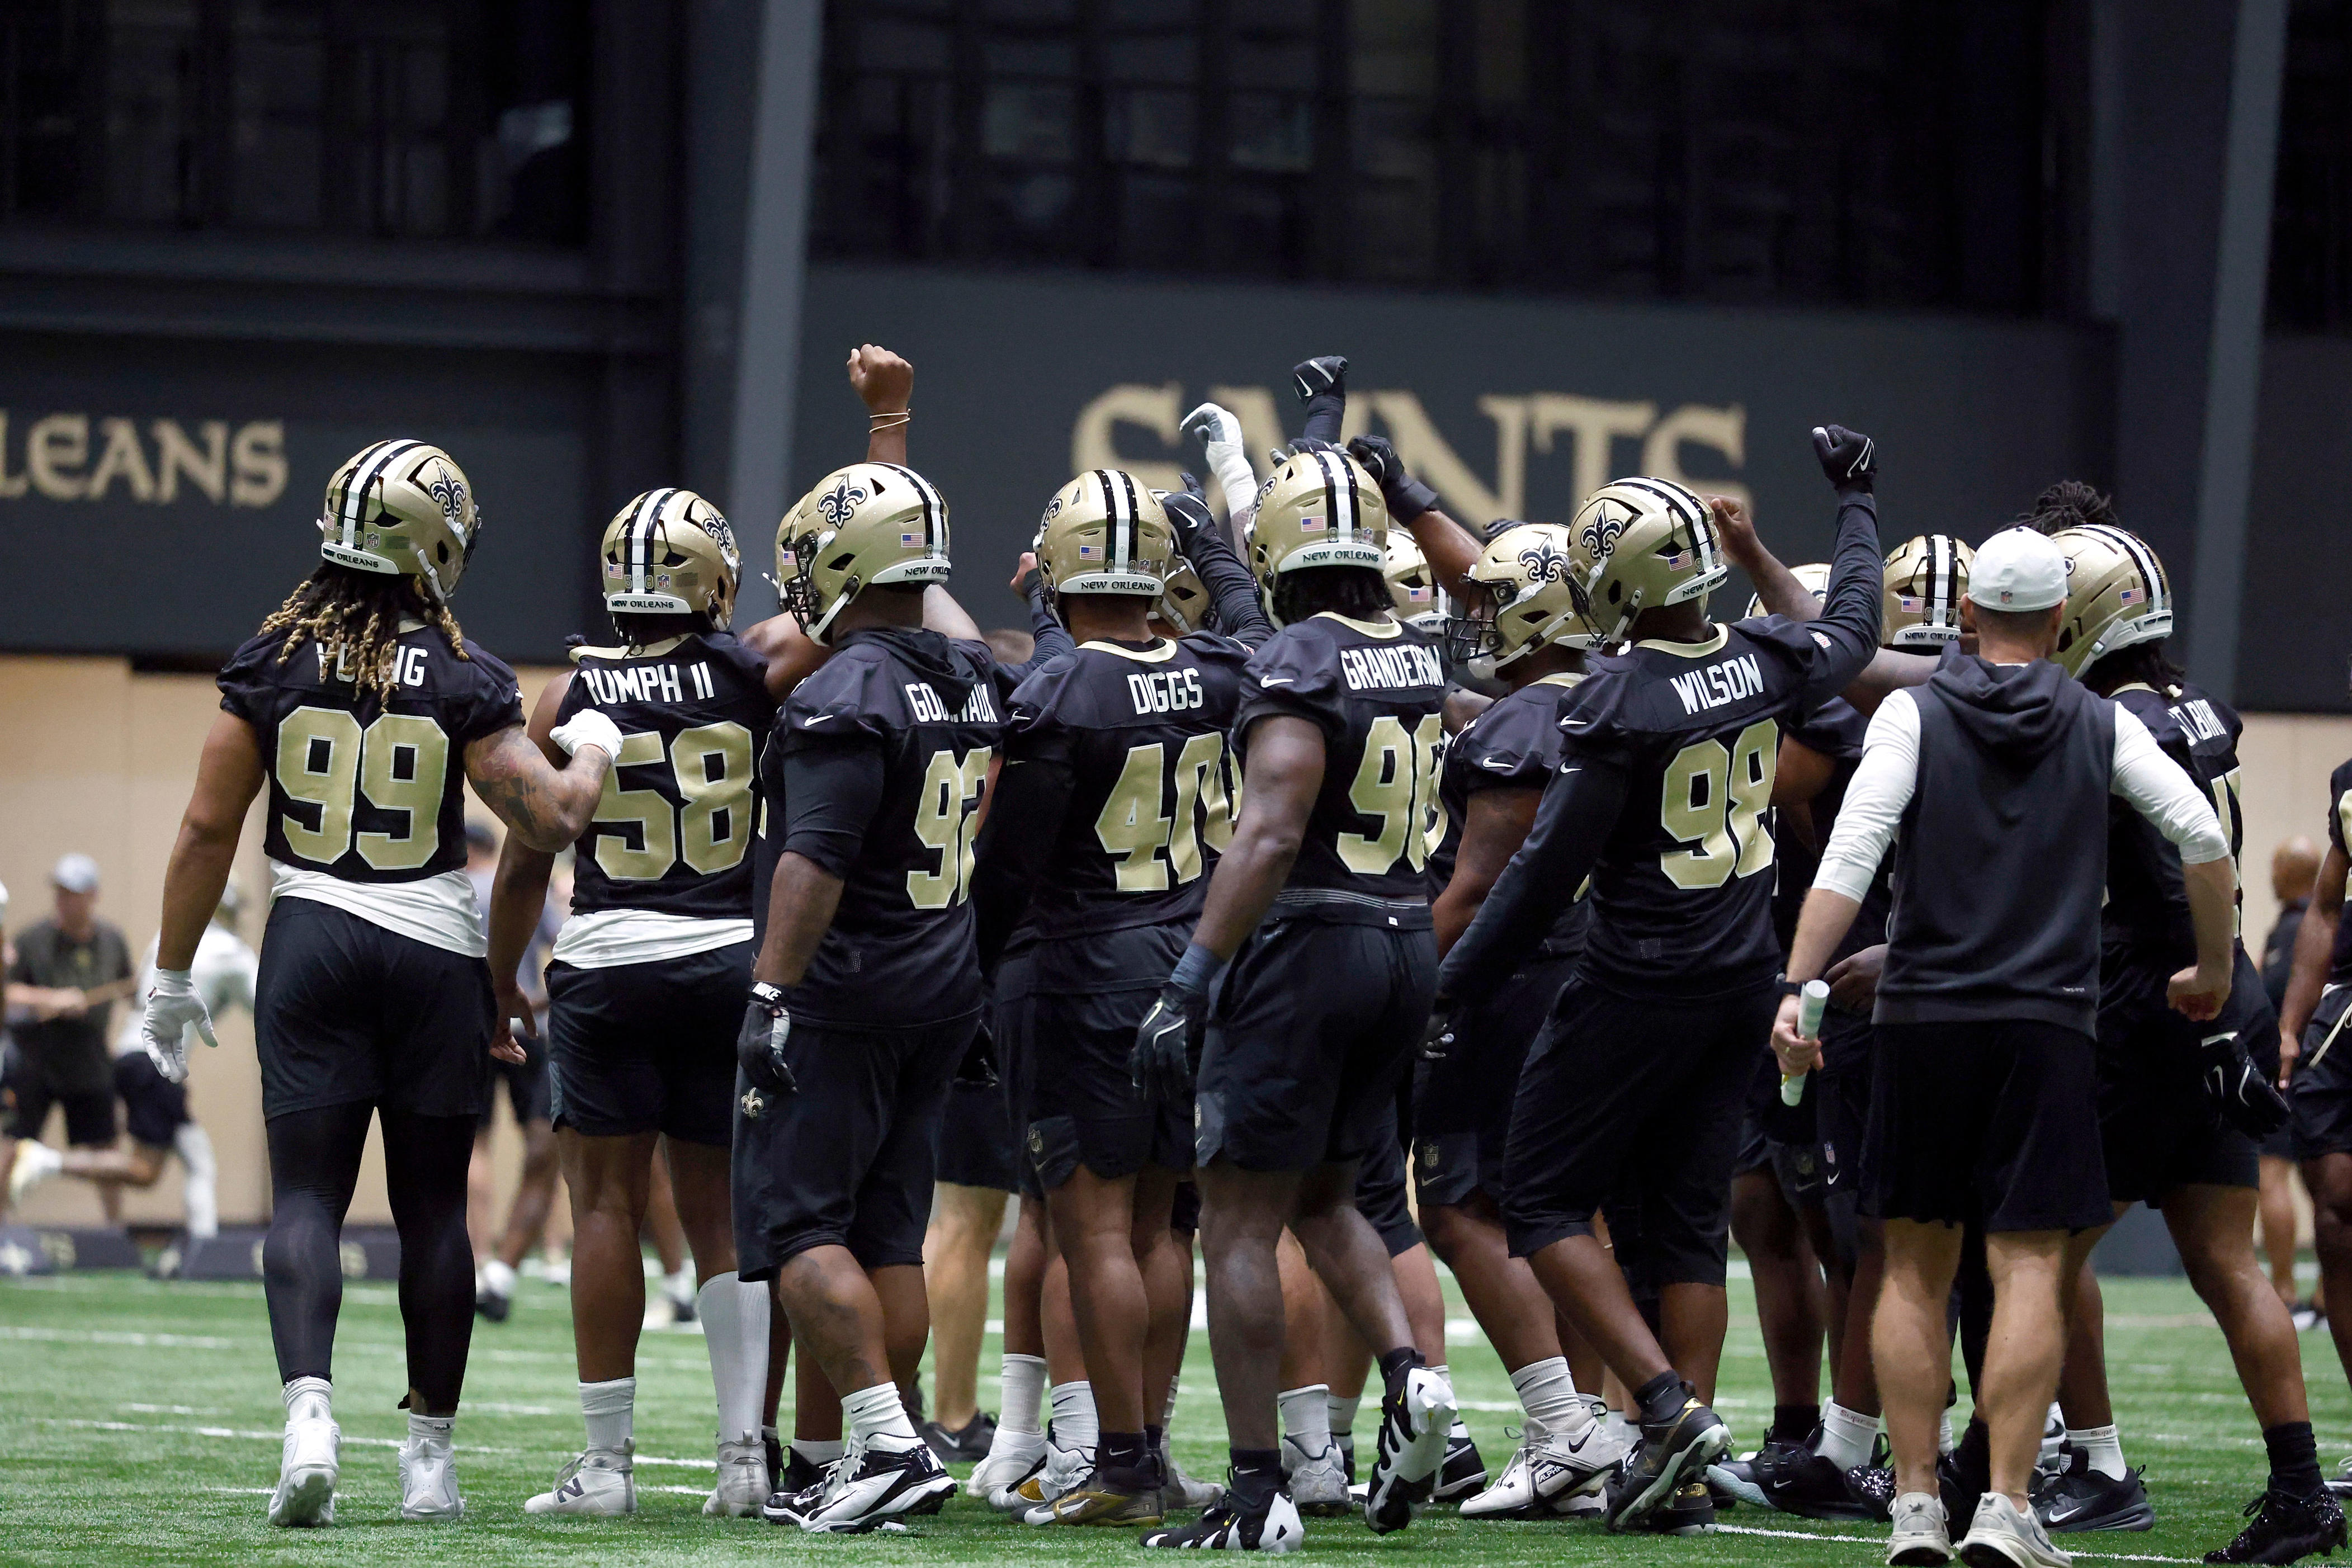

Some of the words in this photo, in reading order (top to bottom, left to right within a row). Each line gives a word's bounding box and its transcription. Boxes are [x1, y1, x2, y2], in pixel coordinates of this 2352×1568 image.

[337, 553, 379, 568] ORLEANS
[1303, 551, 1330, 563] NEW
[1335, 551, 1379, 562] ORLEANS
[904, 566, 929, 577] NEW
[1081, 581, 1107, 589] NEW
[1112, 581, 1155, 591] ORLEANS
[1682, 583, 1704, 597] NEW
[630, 600, 674, 608] ORLEANS
[690, 662, 714, 700] II
[1127, 667, 1203, 715] DIGGS
[1670, 653, 1764, 715] WILSON
[276, 705, 449, 870] 99
[592, 720, 754, 881] 58
[1660, 717, 1778, 890] 98
[1094, 731, 1232, 892] 40
[752, 981, 782, 1001] NIKE
[1539, 1466, 1565, 1483] ALPHA
